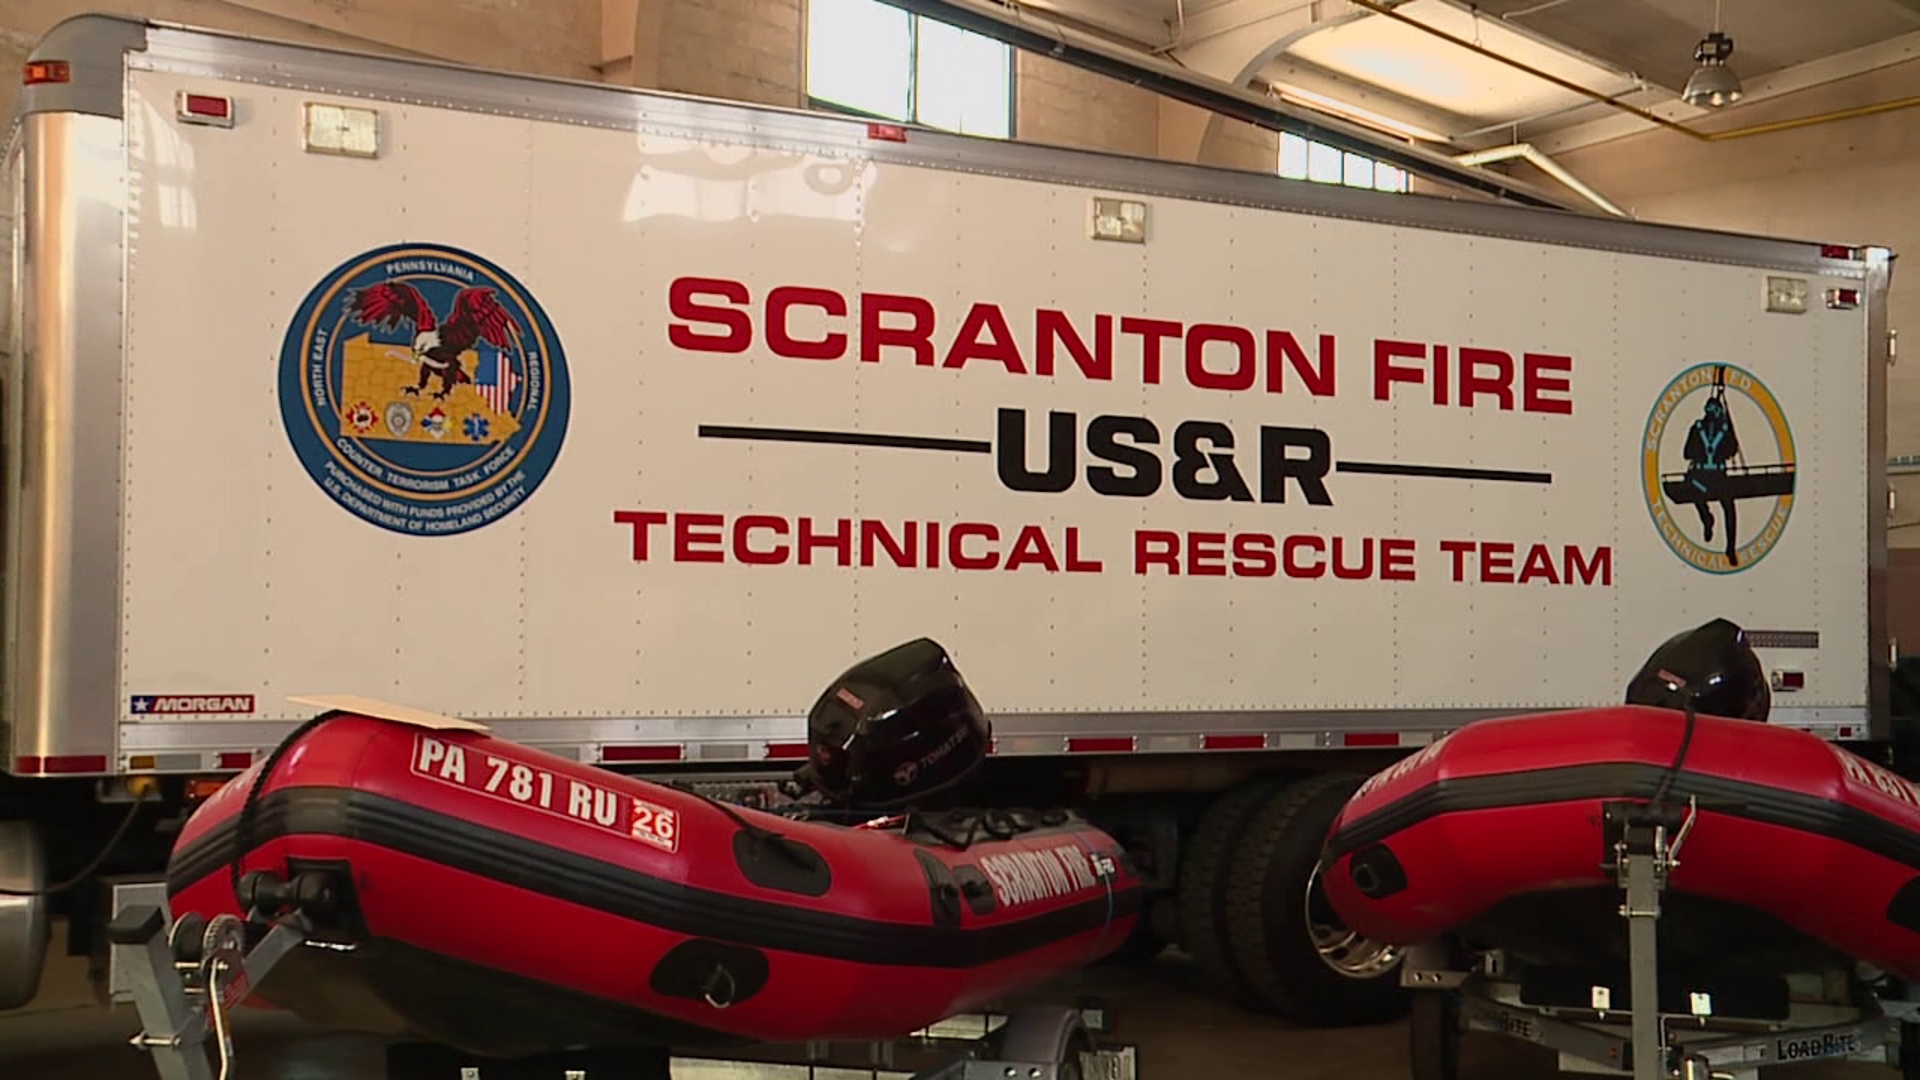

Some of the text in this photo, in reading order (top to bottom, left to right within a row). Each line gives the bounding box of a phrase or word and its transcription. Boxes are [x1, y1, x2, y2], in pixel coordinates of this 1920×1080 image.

[386, 260, 474, 281] PENNSYLVANIA
[312, 329, 328, 407] NORTH EAST
[669, 277, 1572, 415] SCRANTON FIRE
[527, 351, 540, 411] REGIONAL
[1647, 369, 1713, 450] SCRANTON
[336, 437, 515, 490] COUNTER TERRORISM TASK FORCE
[997, 408, 1333, 506] US&R
[325, 460, 526, 518] PURCHASED WITH FUNDS PROVIDED BY THE
[341, 491, 408, 528] DEPARTMENT
[408, 520, 424, 530] OF
[425, 512, 483, 532] HOMELAND
[482, 485, 526, 520] SECURITY
[614, 511, 1612, 586] TECHNICAL RESCUE TEAM
[1651, 502, 1729, 572] TECHNICAL
[154, 697, 250, 712] MORGAN
[419, 737, 617, 827] PA 781 RU
[632, 806, 674, 838] 26
[980, 849, 1072, 907] SCRANTON
[1055, 844, 1097, 891] FIRE
